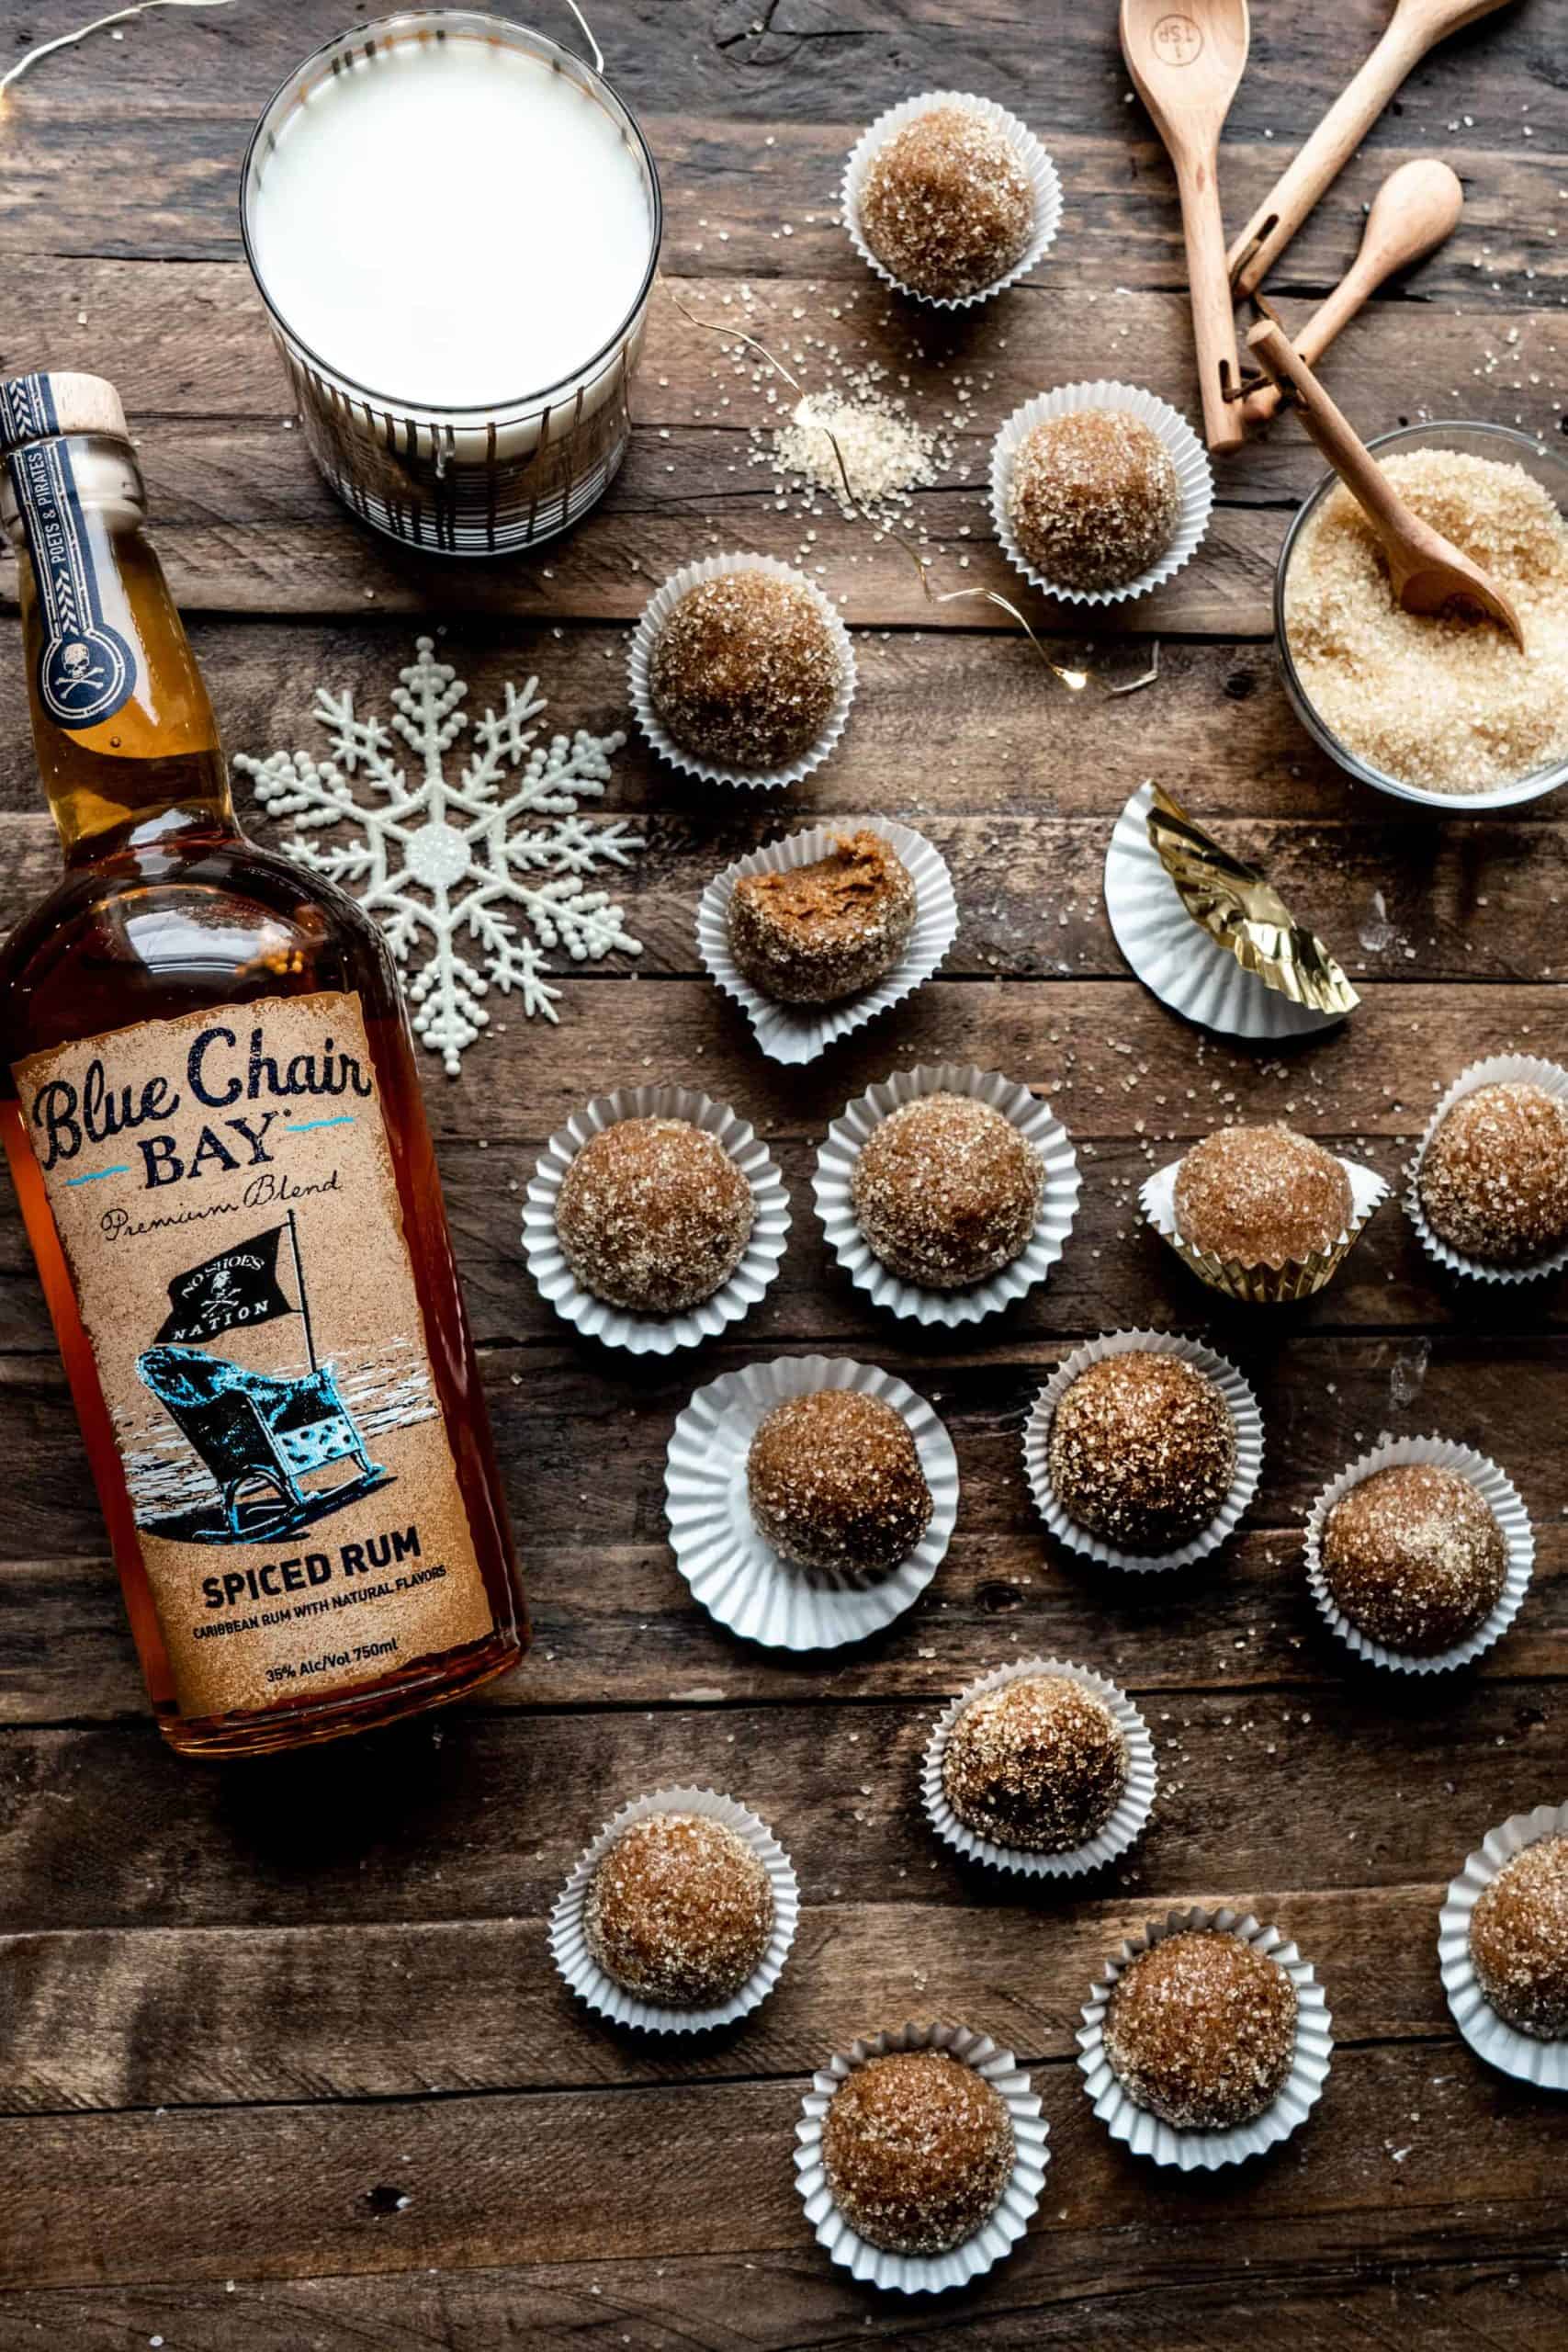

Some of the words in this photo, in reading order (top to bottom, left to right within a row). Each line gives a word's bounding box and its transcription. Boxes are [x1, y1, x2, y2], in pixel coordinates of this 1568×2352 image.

[1157, 25, 1194, 43] TSP
[28, 452, 52, 505] PIRATES
[43, 508, 57, 520] &
[44, 523, 67, 564] POETS
[33, 1058, 181, 1170] Blue
[186, 1027, 372, 1107] Chair
[136, 1110, 279, 1190] BAY
[100, 1201, 240, 1241] Premium
[243, 1170, 341, 1208] Blend
[181, 1272, 205, 1299] NO
[204, 1253, 265, 1278] SHOES
[173, 1299, 269, 1340] NATION
[201, 1553, 333, 1609] SPICED
[339, 1524, 422, 1577] RUM
[193, 1614, 260, 1640] CARIBBEAN
[262, 1608, 292, 1626] RUM
[293, 1600, 330, 1619] WITH
[331, 1582, 395, 1608] NATURAL
[395, 1564, 447, 1592] FLAVORS
[265, 1665, 297, 1683] 35%
[299, 1652, 352, 1678] Alc/Vol
[352, 1637, 400, 1663] 750ml
